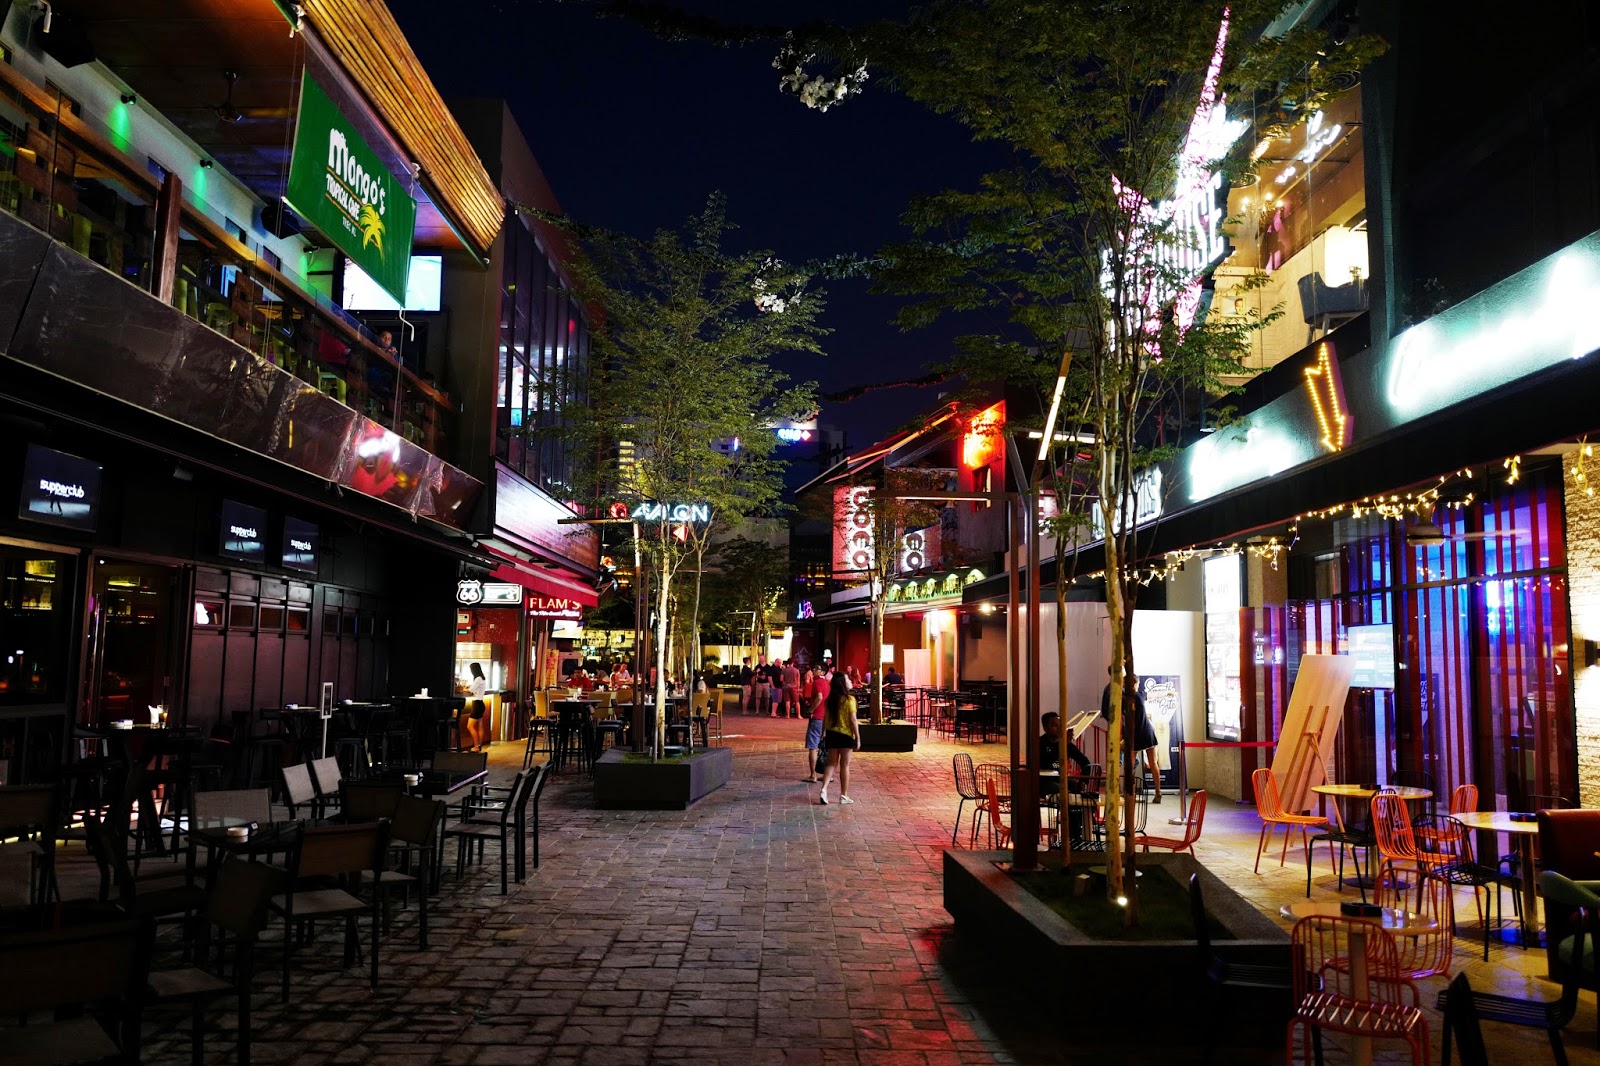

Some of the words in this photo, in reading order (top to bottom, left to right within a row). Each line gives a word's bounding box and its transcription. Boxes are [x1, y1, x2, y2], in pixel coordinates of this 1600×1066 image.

[326, 173, 348, 210] TROPICAL
[40, 479, 85, 498] supperclub
[230, 525, 257, 538] supperclub
[290, 539, 311, 551] supperclub
[460, 586, 479, 601] 66
[529, 597, 580, 610] FLAM'S
